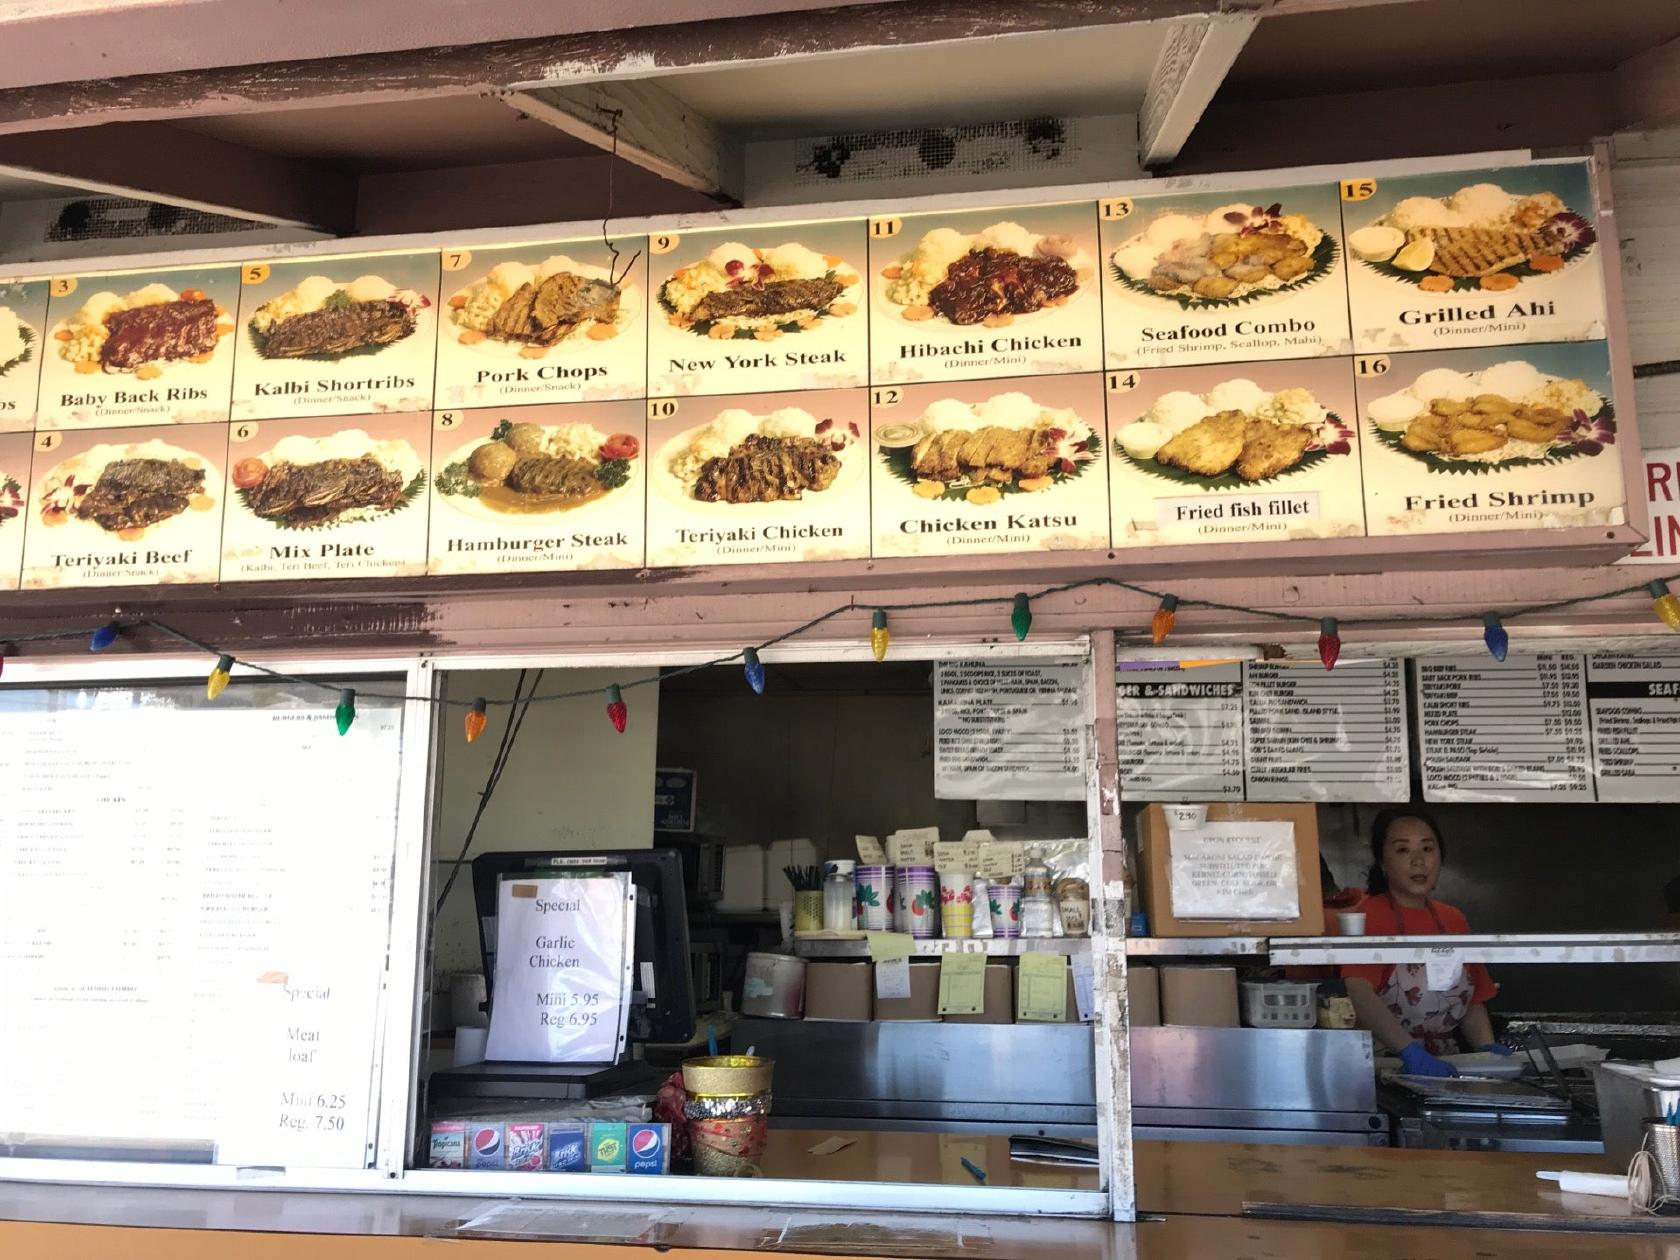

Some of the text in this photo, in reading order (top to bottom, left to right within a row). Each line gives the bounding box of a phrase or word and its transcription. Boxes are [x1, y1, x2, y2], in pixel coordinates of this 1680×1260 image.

[1346, 183, 1373, 198] 15
[1103, 202, 1129, 217] 13
[872, 221, 896, 235] 11
[658, 236, 670, 250] 9
[451, 255, 462, 268] 7
[249, 267, 262, 281] 5
[58, 280, 69, 294] 3
[1398, 301, 1556, 325] Grilled Ahi
[1141, 318, 1316, 342] Seafood Combo
[1433, 322, 1526, 337] (Dinner/Mini)
[900, 335, 1083, 359] Hibachi Chicken
[668, 349, 847, 373] New York Steak
[944, 354, 1028, 369] (Dinner/Mini)
[1360, 359, 1387, 374] 16
[477, 363, 608, 384] Pork Chops
[254, 375, 416, 397] Kalbi Shortribs
[499, 382, 582, 395] (Dinner/Snack)
[1109, 374, 1136, 389] 14
[60, 386, 209, 409] Baby Back Ribs
[874, 390, 898, 405] 12
[650, 402, 675, 416] 10
[441, 412, 453, 426] 8
[237, 425, 249, 438] 6
[41, 435, 53, 448] 4
[1405, 489, 1596, 511] Fried Shrimp
[1176, 498, 1310, 521] Fried fish fillet
[1448, 508, 1544, 524] (Dinner/Mini)
[900, 512, 1078, 535] Chicken Katsu
[1198, 520, 1287, 535] (Dinner/Mini)
[675, 523, 844, 545] Teriyaki Chicken
[946, 533, 1031, 547] (Dinner/Mini)
[447, 531, 629, 553] Hamburger Steak
[716, 542, 797, 555] (Dinner/Mini)
[50, 548, 193, 569] Teriyaki Beef
[269, 542, 375, 560] Mix Plate
[1145, 684, 1154, 696] &
[1158, 683, 1235, 696] SANDWICHES
[1648, 683, 1680, 696] SEAF
[535, 899, 581, 915] Special
[535, 935, 576, 950] Garlic
[528, 954, 580, 970] Chicken
[283, 986, 331, 1002] Special
[536, 992, 600, 1007] Mini 5.95
[540, 1011, 598, 1030] Reg 6.95
[287, 1026, 320, 1042] Meat
[288, 1048, 317, 1063] loaf
[317, 1094, 346, 1109] 6.25
[315, 1115, 345, 1131] 7.50
[634, 1158, 658, 1169] pepsi
